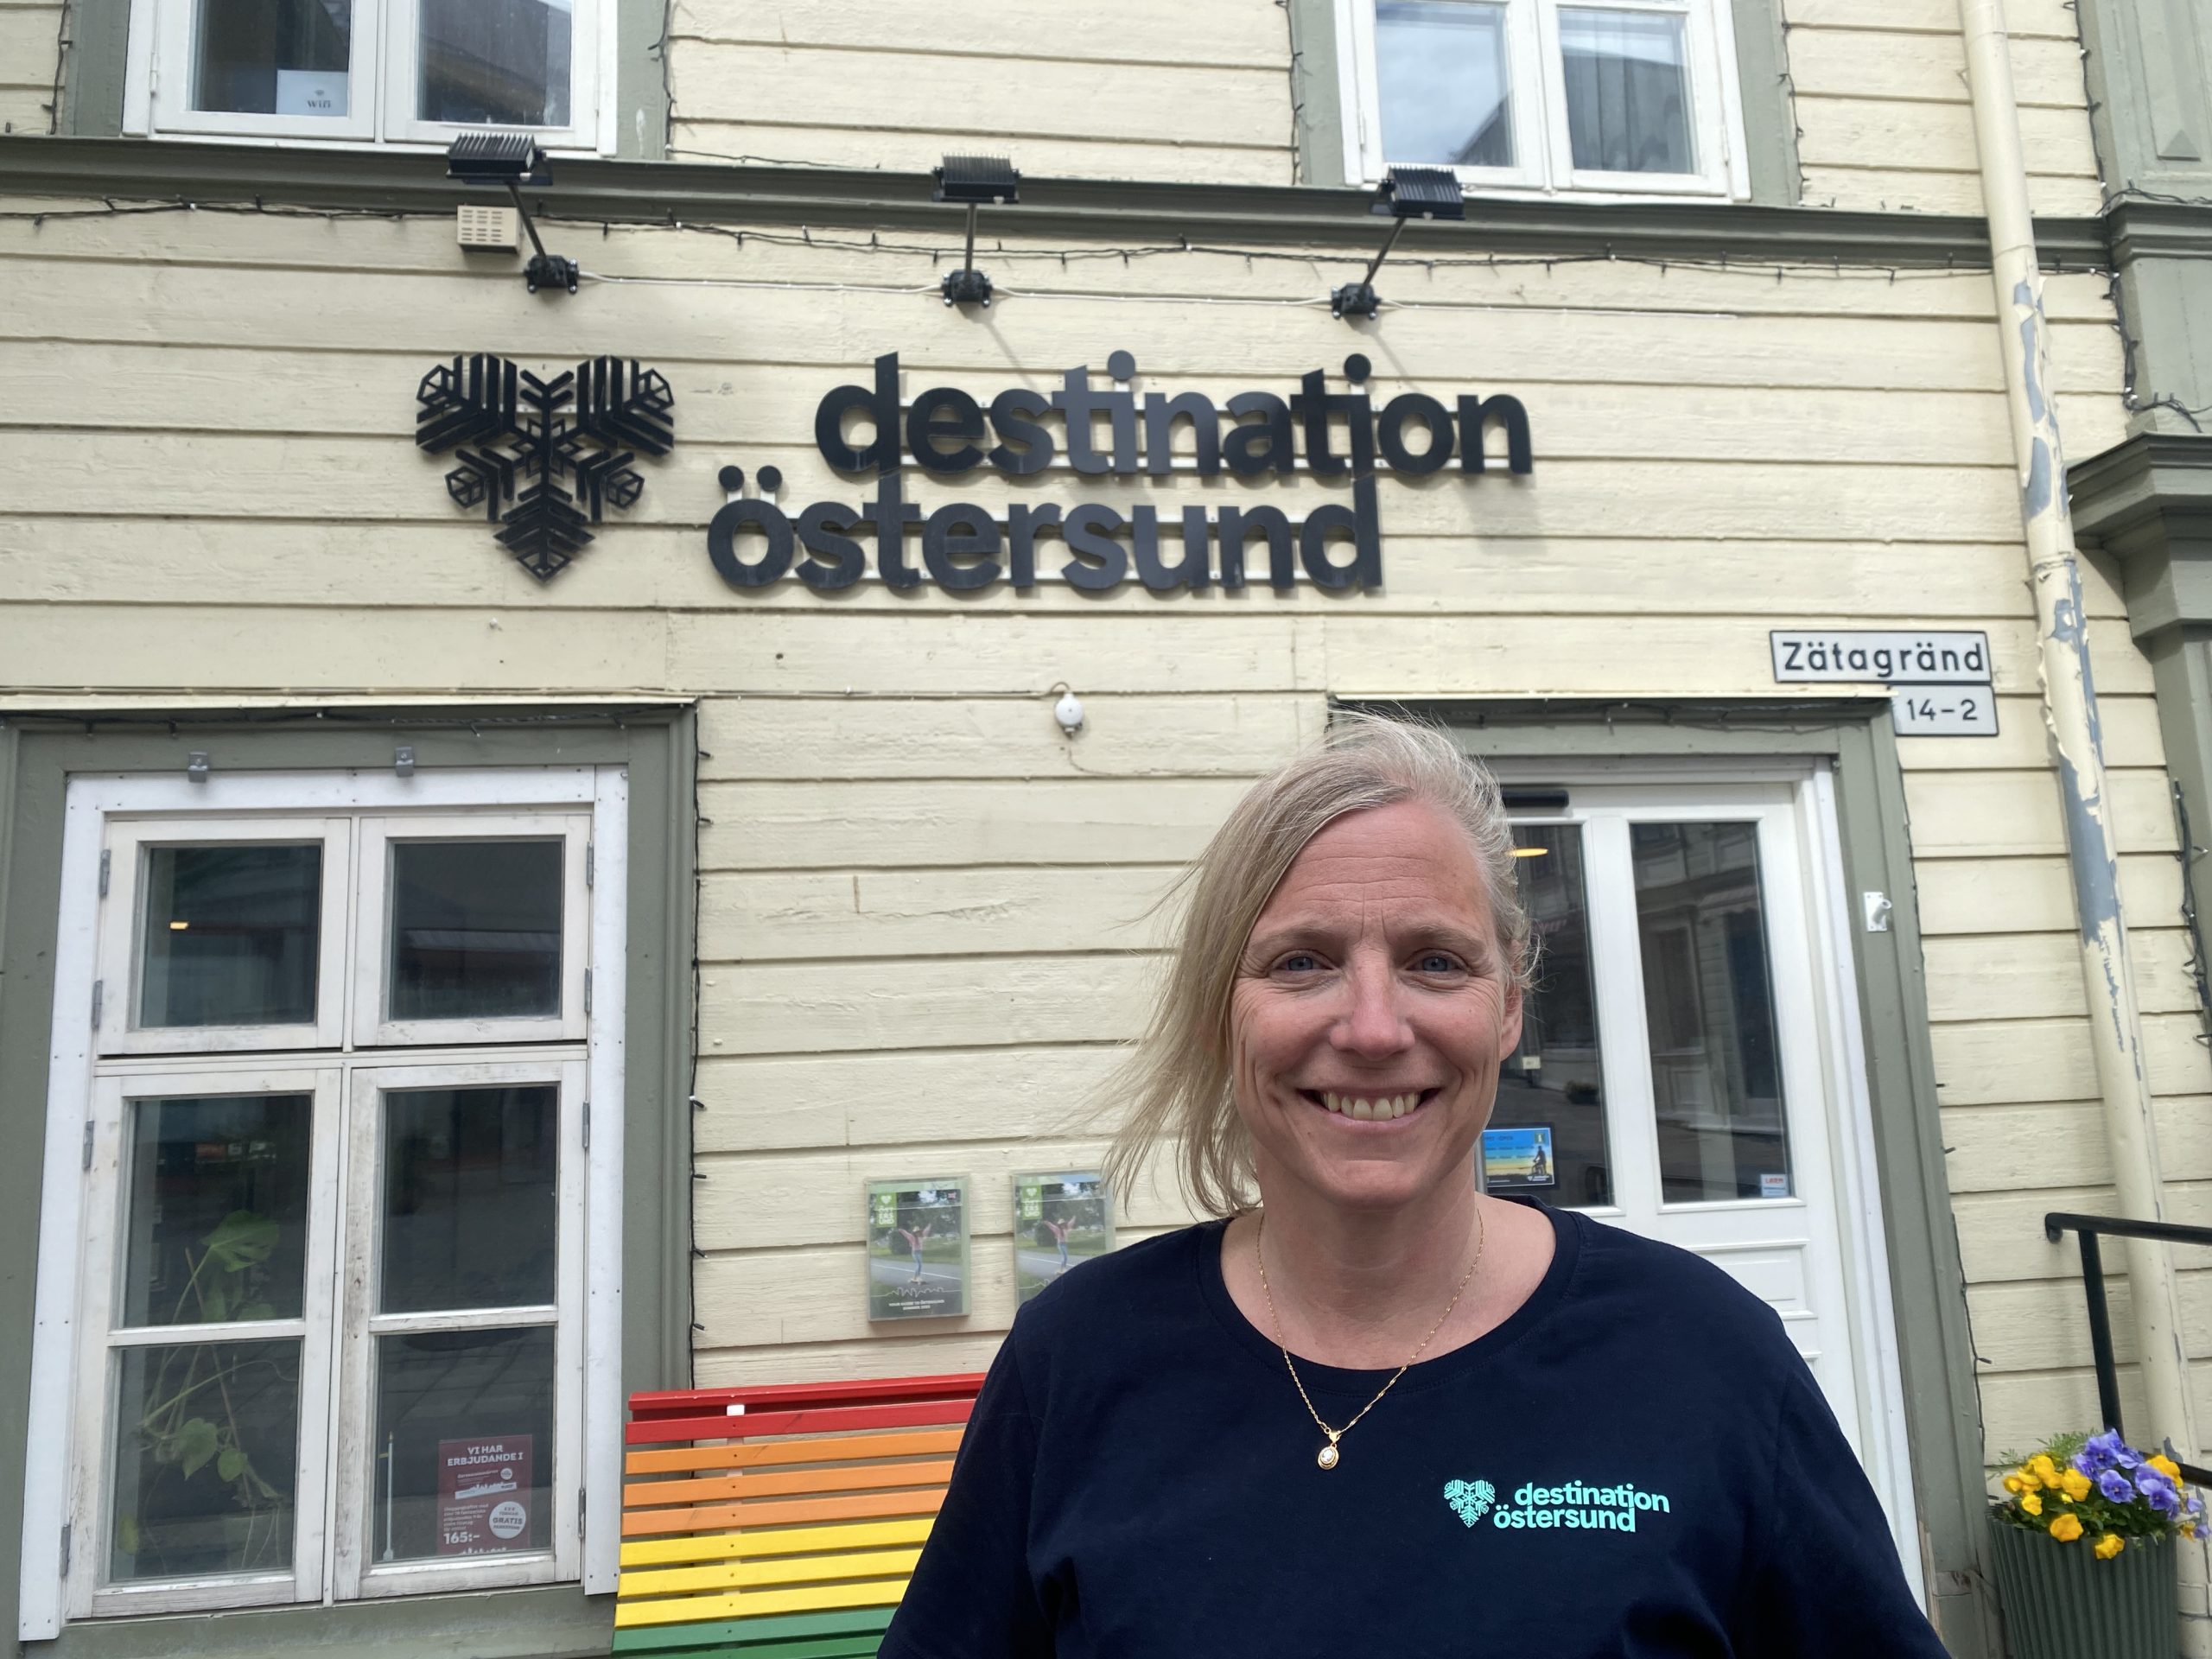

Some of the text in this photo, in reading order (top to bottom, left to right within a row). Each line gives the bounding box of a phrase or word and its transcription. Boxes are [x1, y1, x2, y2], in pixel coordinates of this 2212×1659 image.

[814, 350, 1534, 479] destination
[707, 465, 1382, 592] östersund
[1782, 642, 1985, 678] Zätagränd
[448, 1452, 517, 1466] ERBJUDANDE
[467, 1445, 503, 1455] VI HAR
[1514, 1479, 1670, 1514] destination
[1493, 1503, 1637, 1533] östersund
